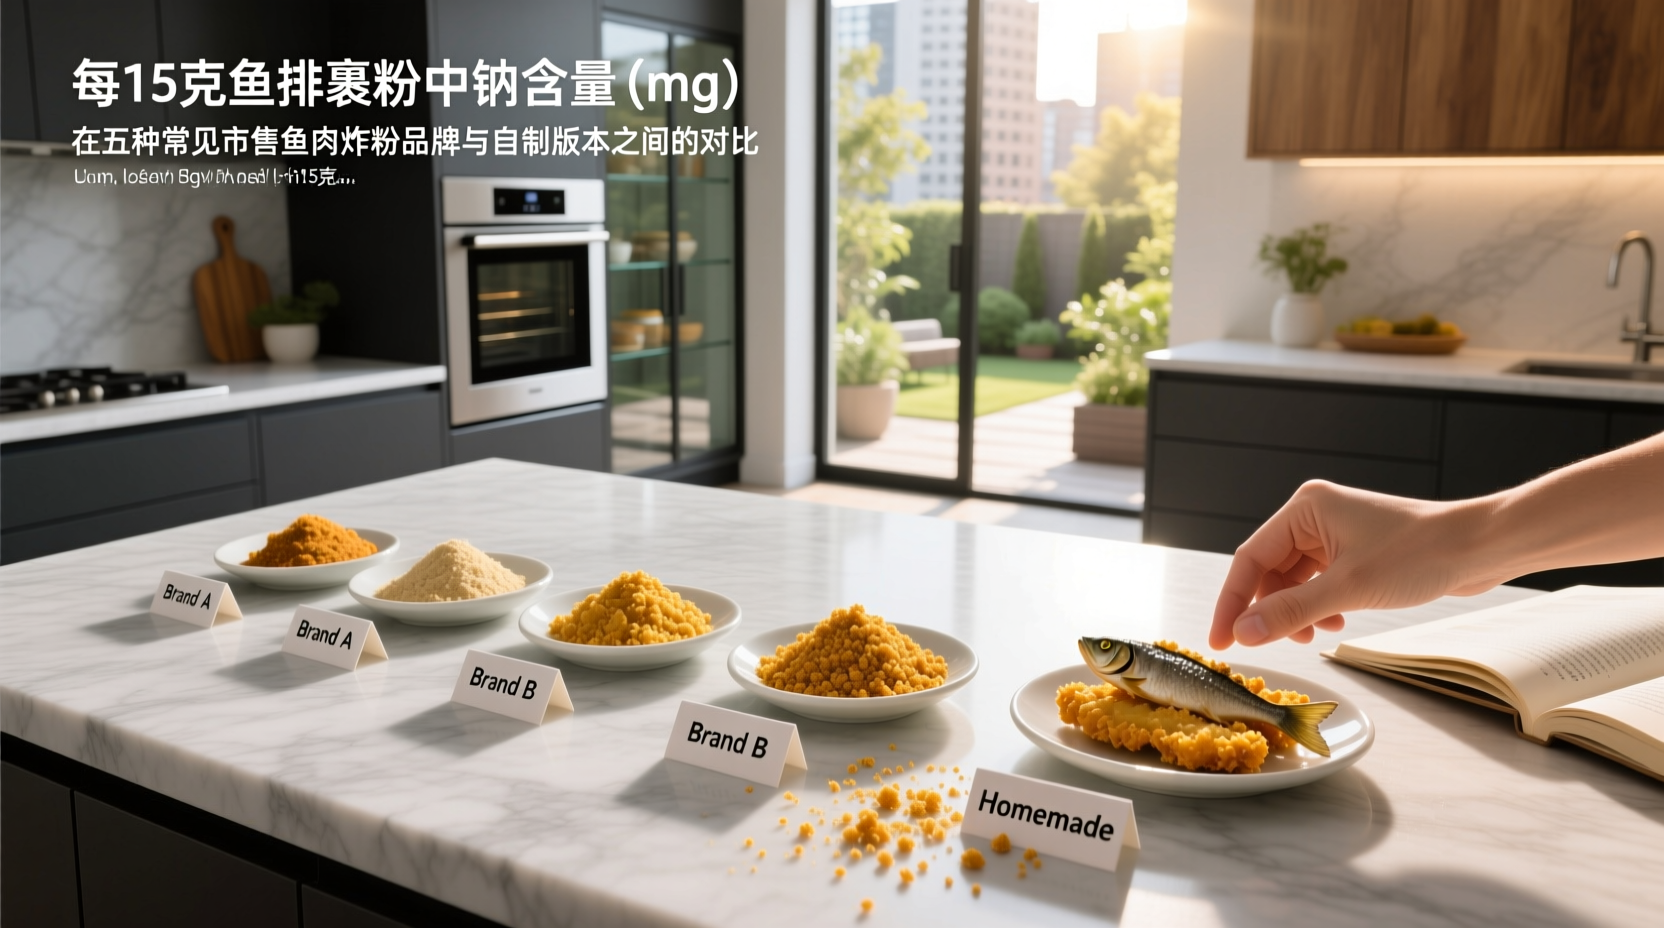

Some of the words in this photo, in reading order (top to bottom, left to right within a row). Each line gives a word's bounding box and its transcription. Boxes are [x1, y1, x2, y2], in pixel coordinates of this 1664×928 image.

[163, 583, 201, 607] Brand
[200, 592, 212, 610] A
[296, 619, 341, 646] Brand
[340, 631, 353, 650] A
[469, 666, 522, 696] Brand
[521, 679, 538, 700] B
[687, 721, 749, 754] Brand
[751, 736, 769, 759] B
[978, 789, 1114, 841] Homemade
